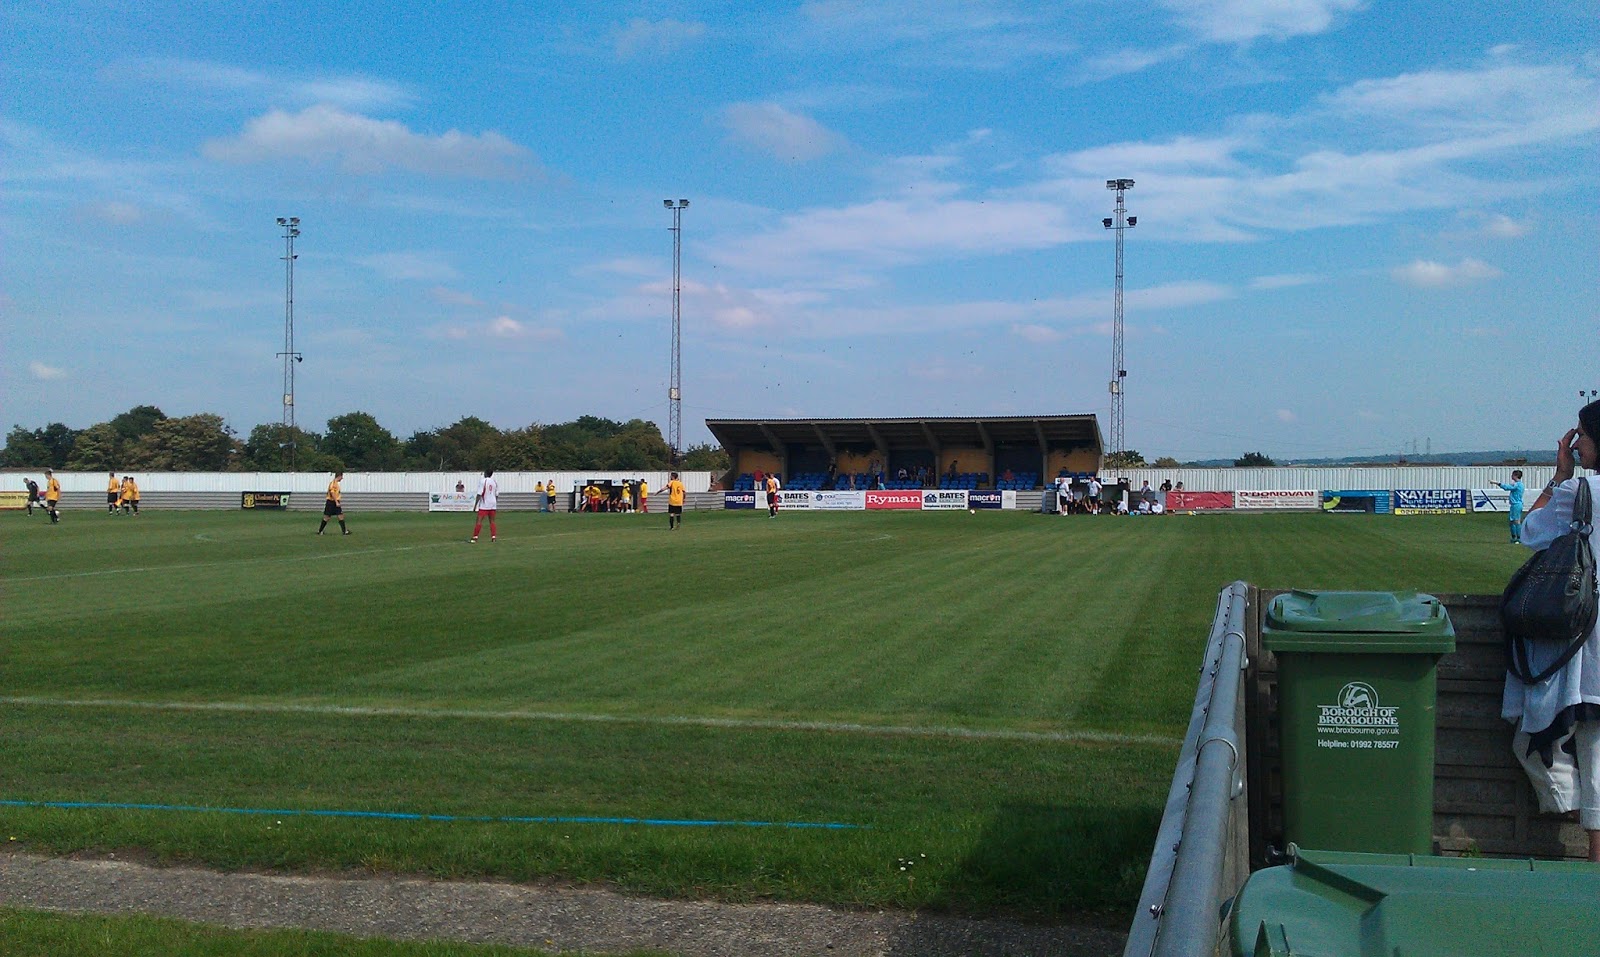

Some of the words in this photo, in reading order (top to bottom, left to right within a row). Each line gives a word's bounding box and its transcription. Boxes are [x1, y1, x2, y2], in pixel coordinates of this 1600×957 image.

[725, 494, 755, 502] macron
[784, 492, 809, 500] BATES
[969, 494, 1001, 502] macron
[1399, 490, 1462, 499] KAYLEIGH
[867, 494, 921, 505] Ryman
[1322, 707, 1378, 717] BOROUGH
[1379, 708, 1396, 717] OF
[1318, 715, 1399, 725] BROXBOURNE
[1317, 727, 1399, 735] www.broxbourne.gov.uk
[1317, 739, 1349, 749] Helpline:
[1350, 740, 1373, 748] 01992
[1373, 740, 1399, 749] 785577
